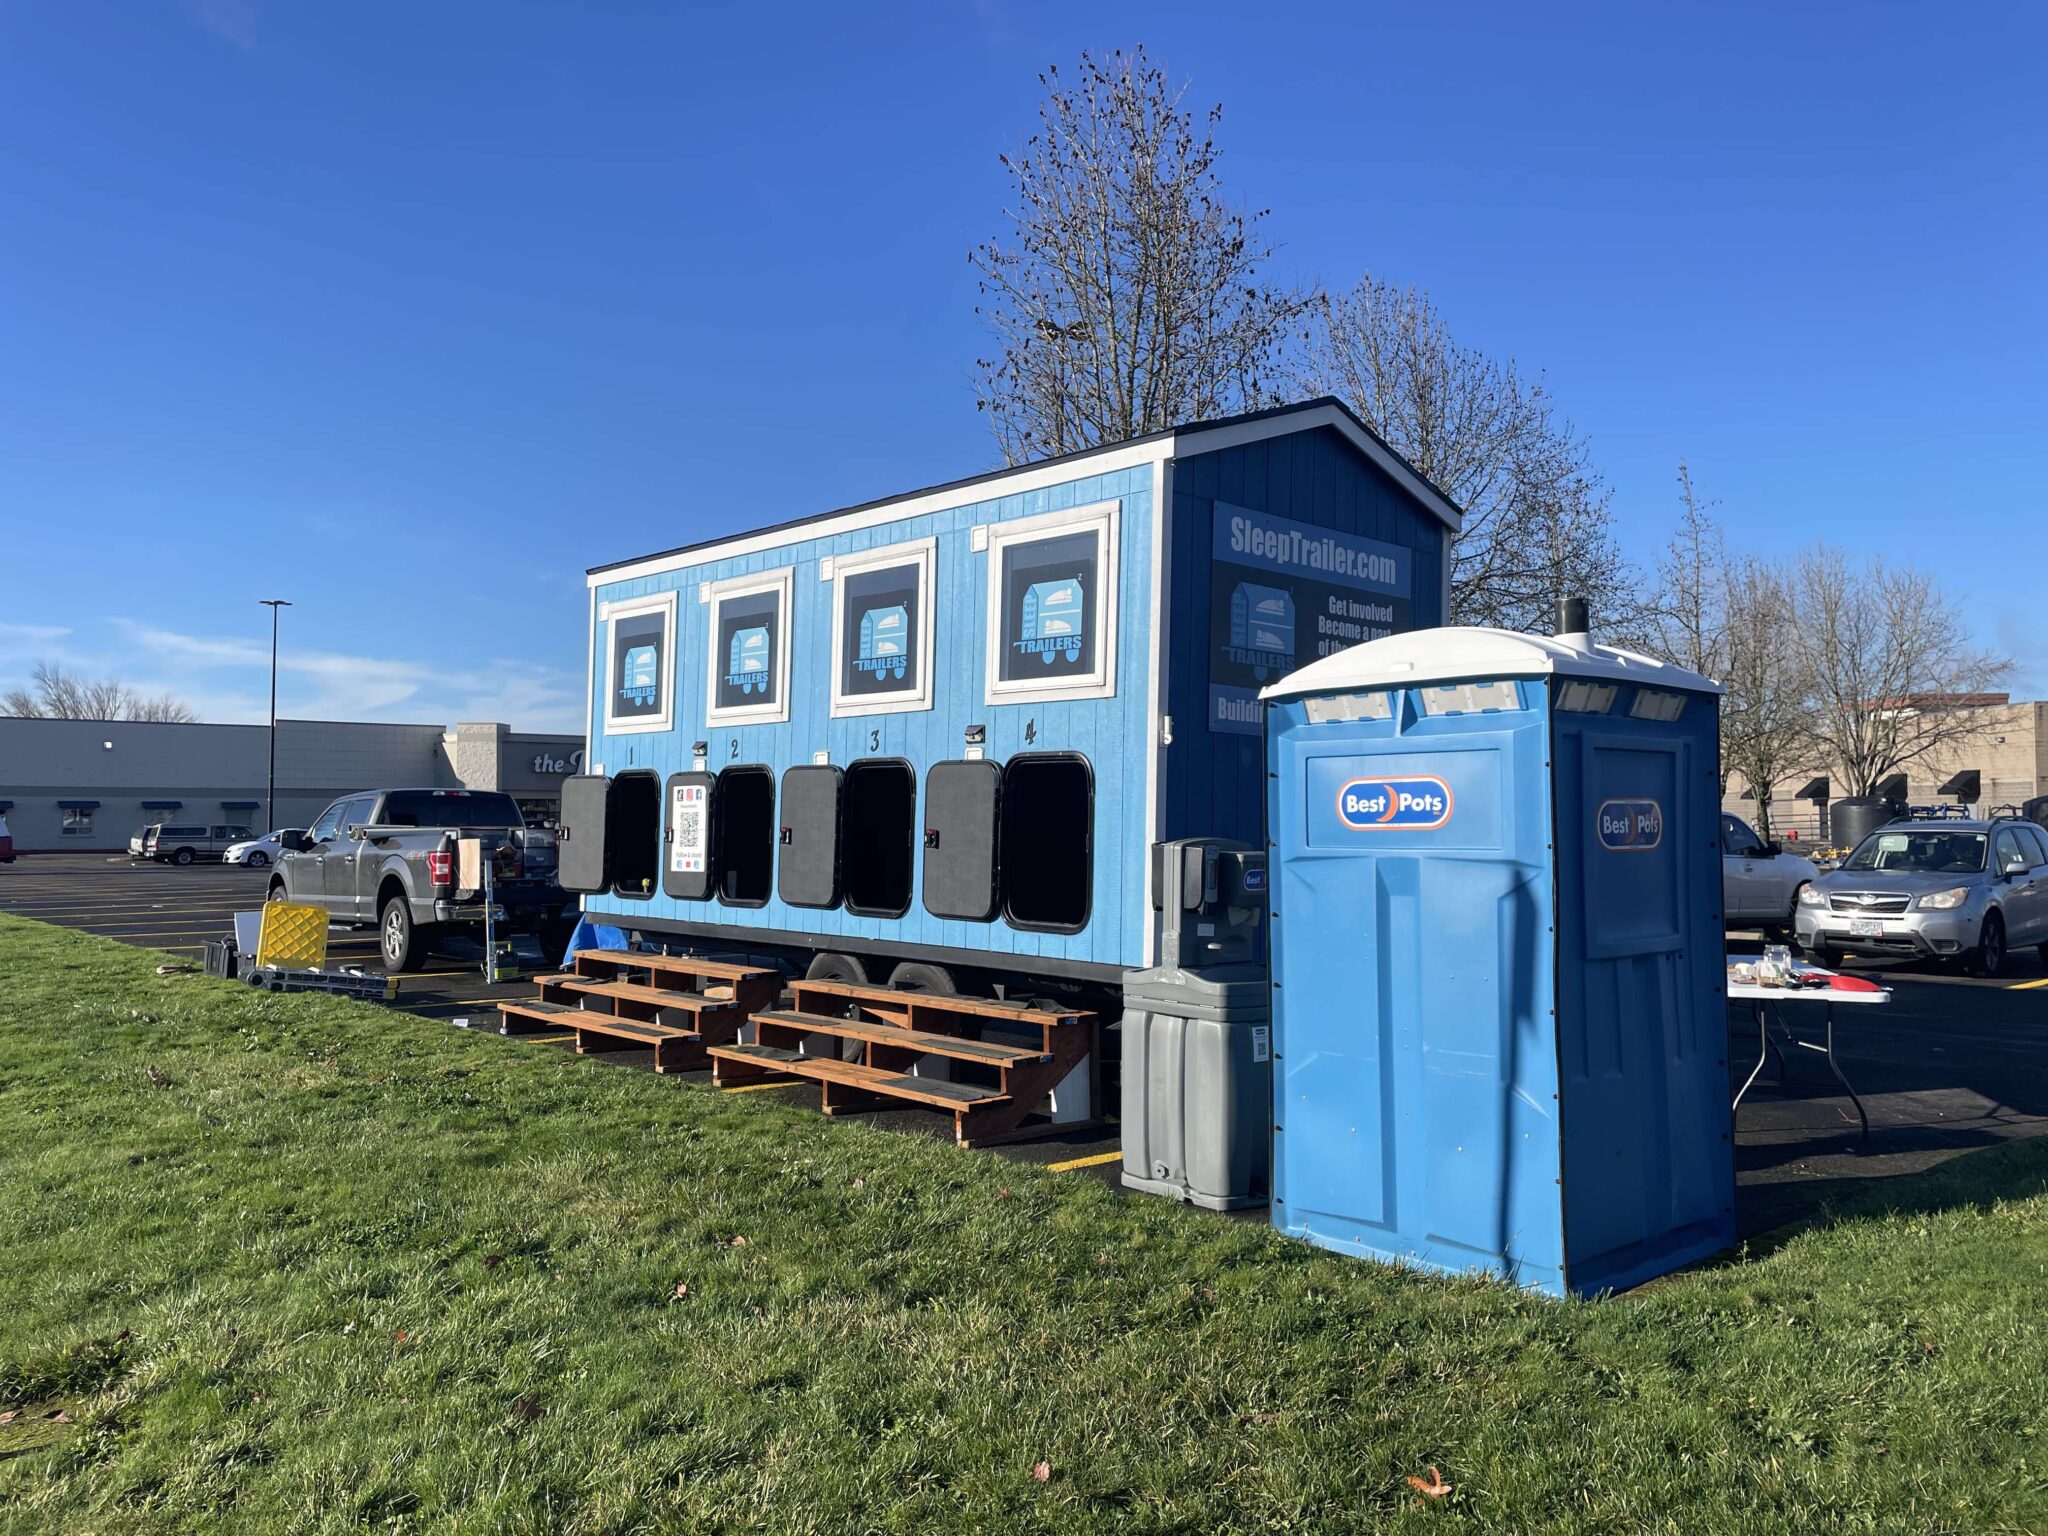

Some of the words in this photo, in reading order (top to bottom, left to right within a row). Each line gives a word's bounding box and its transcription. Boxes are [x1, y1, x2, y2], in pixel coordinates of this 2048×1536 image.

[1231, 516, 1396, 585] SleepTrailer.com
[1329, 595, 1347, 617] Get
[1349, 600, 1393, 622] involved
[1318, 615, 1361, 639] Become
[1363, 626, 1369, 641] a
[1019, 636, 1082, 653] TRAILERS
[1318, 639, 1329, 656] of
[857, 656, 907, 671] TRAILERS
[1229, 648, 1295, 670] TRAILERS
[728, 672, 769, 685] TRAILERS
[622, 687, 656, 698] TRAILERS
[870, 730, 880, 752] 3
[1025, 718, 1036, 745] 4
[629, 746, 633, 765] 1
[731, 739, 739, 759] 2
[534, 753, 564, 773] the
[1346, 794, 1386, 813] Best
[1399, 793, 1443, 811] Pots
[1603, 815, 1630, 834] Best
[1637, 815, 1659, 833] Pots
[1246, 876, 1261, 885] Best
